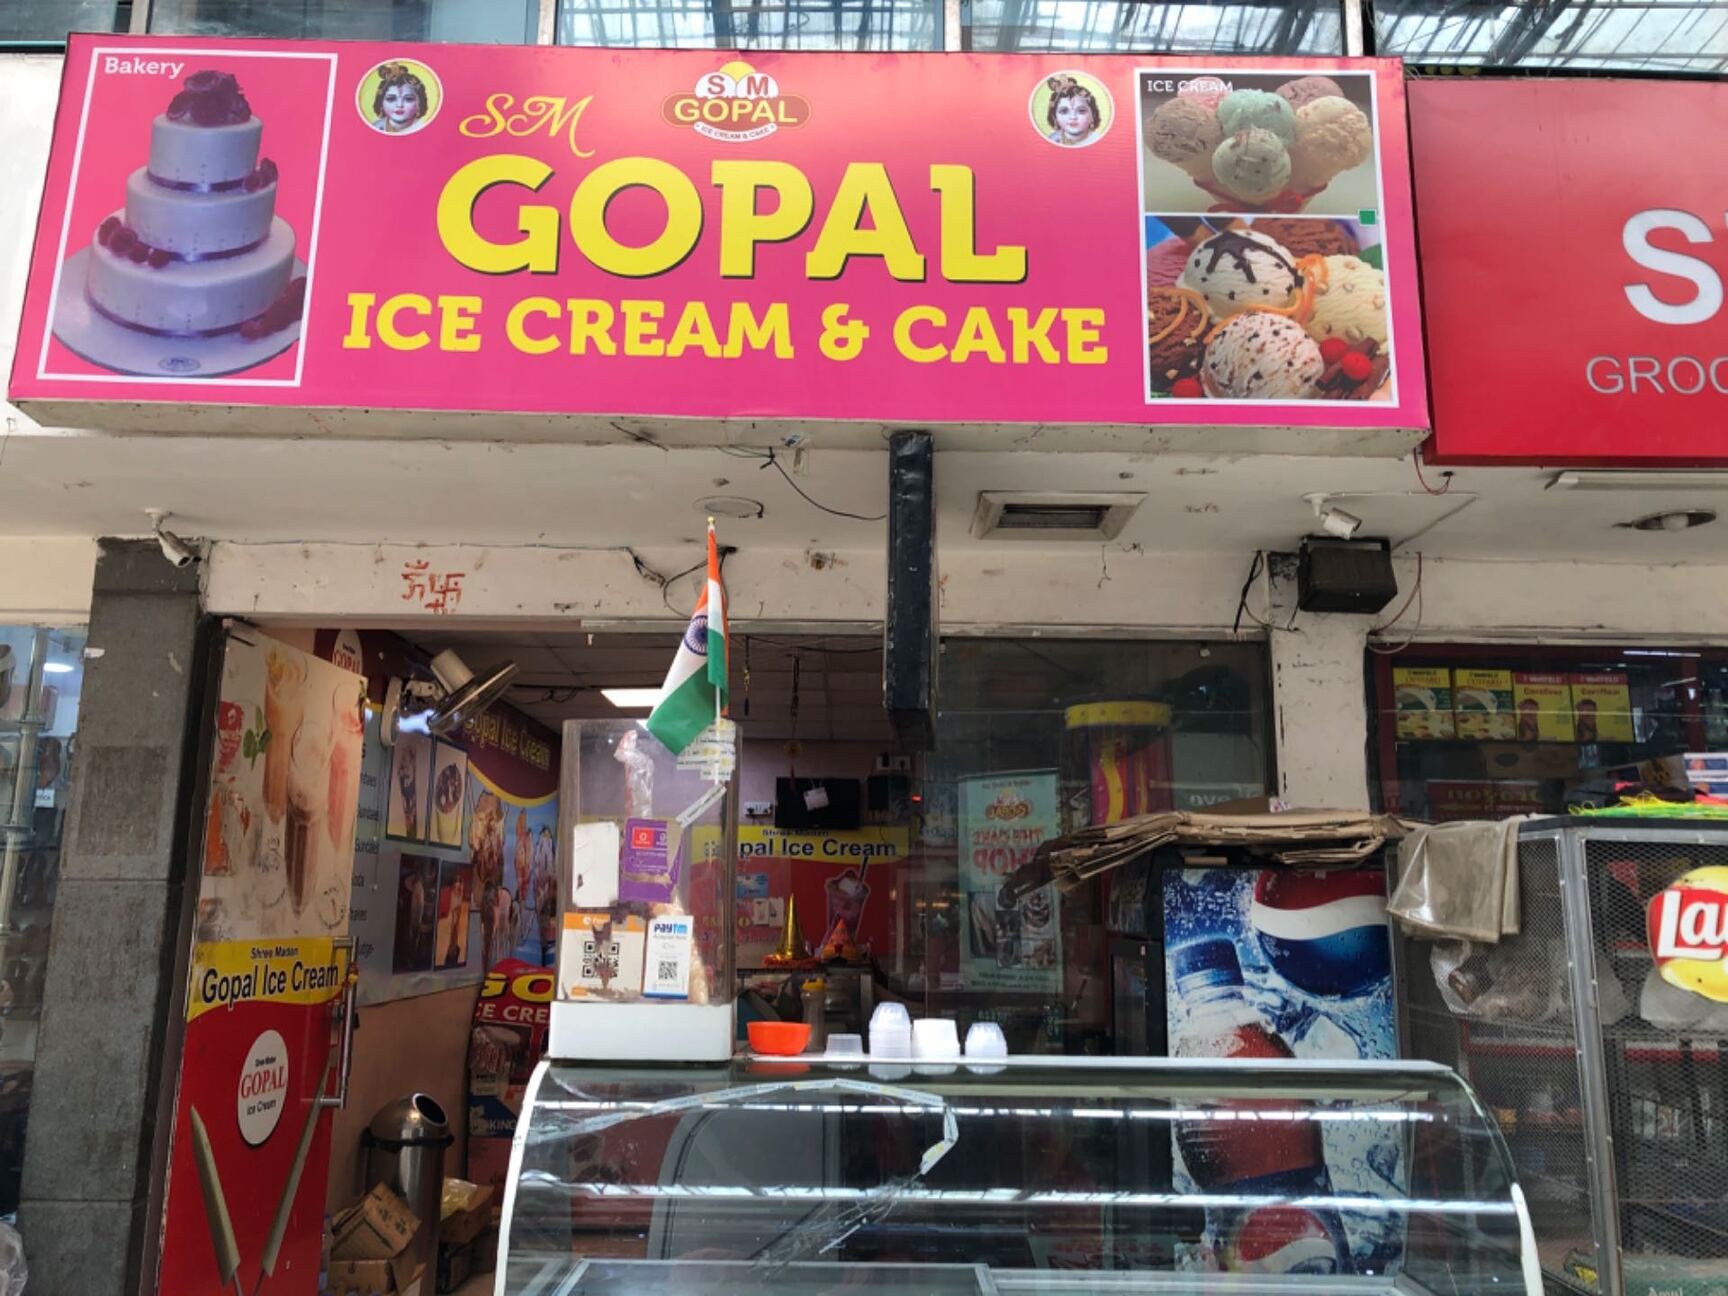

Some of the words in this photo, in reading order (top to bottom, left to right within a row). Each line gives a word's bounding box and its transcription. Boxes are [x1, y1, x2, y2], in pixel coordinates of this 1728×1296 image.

[104, 56, 184, 79] Bakery
[1147, 80, 1174, 92] ICE
[1177, 80, 1233, 92] CREAM
[459, 93, 596, 157] SM
[674, 98, 798, 123] GOPAL
[714, 130, 740, 139] CREAM
[749, 127, 769, 138] CAKE
[438, 155, 1027, 281] GOPAL
[1623, 207, 1728, 325] S
[344, 294, 482, 351] ICE
[507, 298, 794, 359] CREAM
[820, 304, 869, 361] &
[895, 307, 1108, 363] CAKE
[783, 839, 815, 856] Ice
[822, 839, 896, 857] Cream
[1657, 889, 1728, 973] La
[202, 964, 259, 1010] Gopal
[262, 963, 287, 996] Ice
[291, 960, 340, 993] Cream
[241, 1066, 286, 1099] GOPAL
